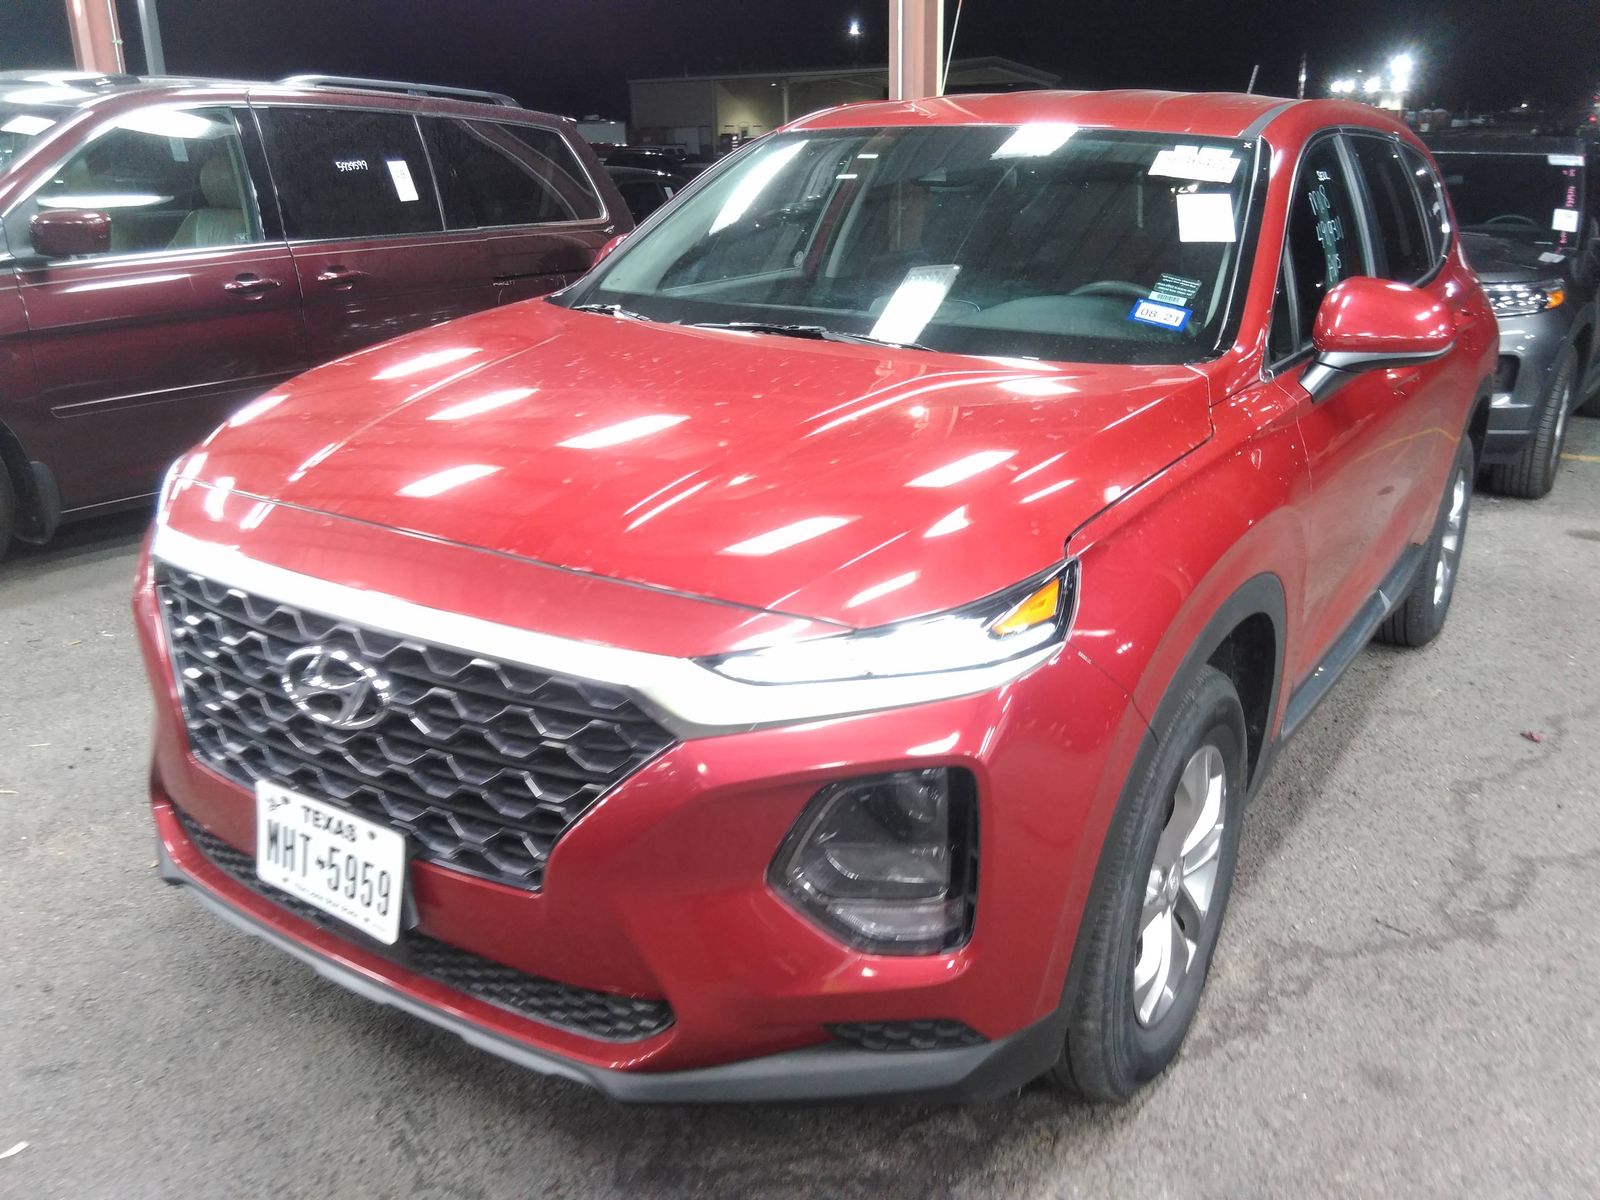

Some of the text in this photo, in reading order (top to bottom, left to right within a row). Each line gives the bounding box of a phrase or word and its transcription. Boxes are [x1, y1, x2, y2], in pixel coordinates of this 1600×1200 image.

[1140, 308, 1180, 323] 08 21
[302, 805, 357, 843] TEXAS
